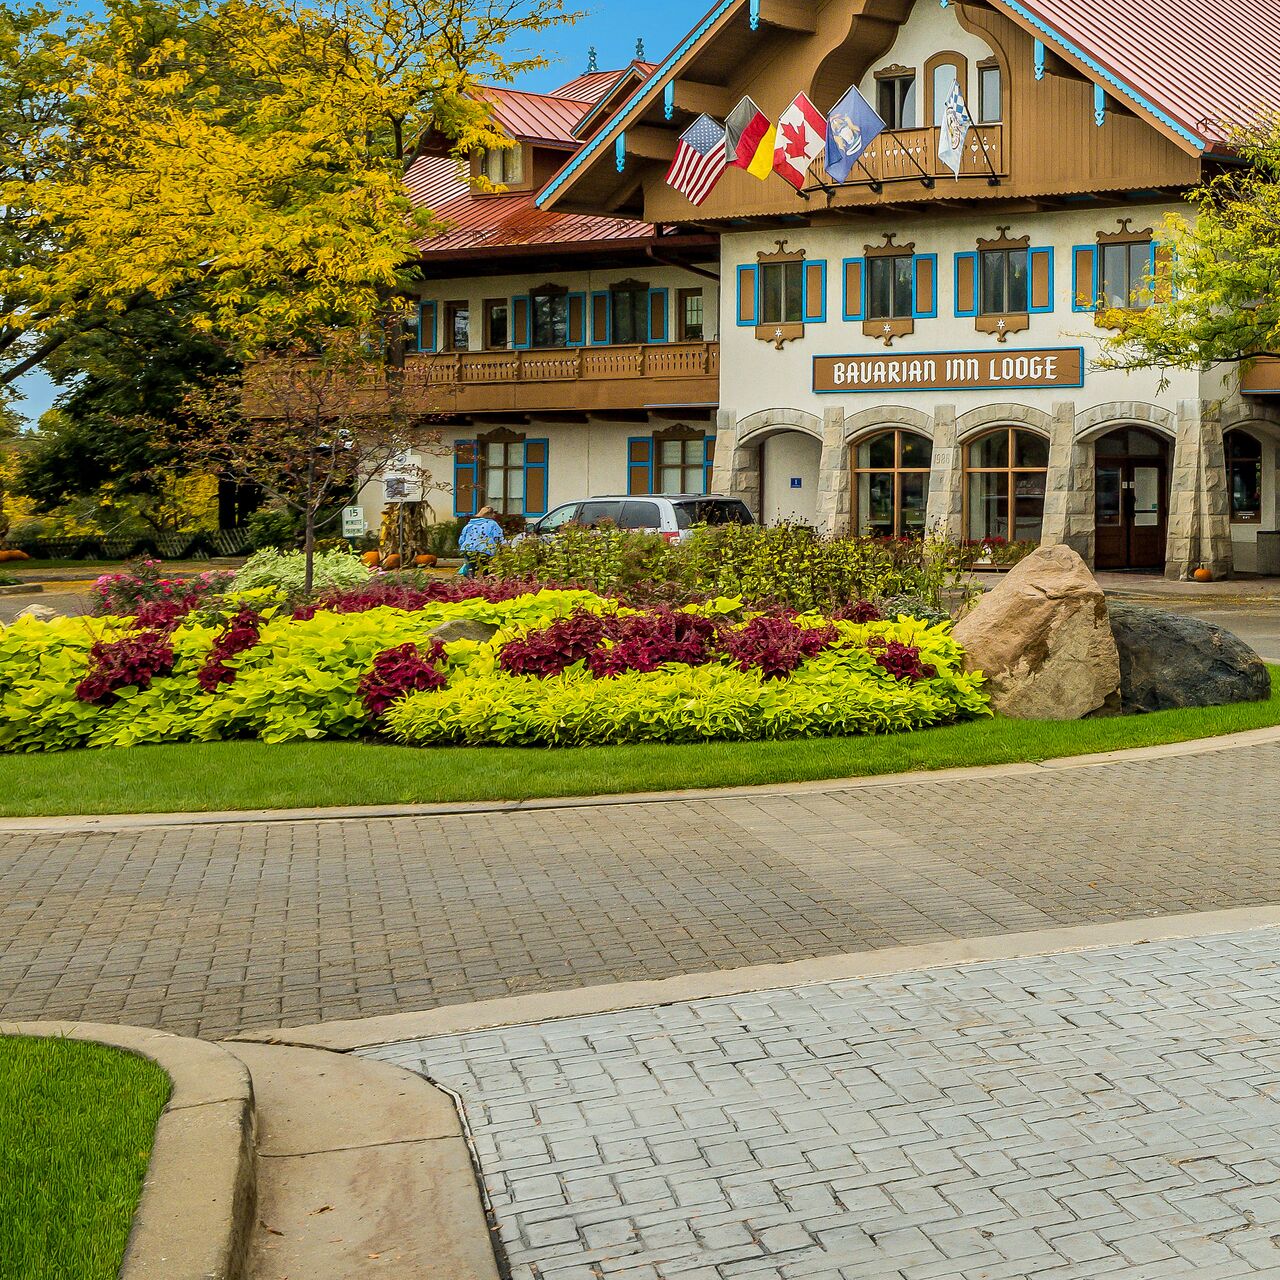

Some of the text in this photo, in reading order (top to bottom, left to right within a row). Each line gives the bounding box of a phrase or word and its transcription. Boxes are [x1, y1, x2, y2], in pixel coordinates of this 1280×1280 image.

[833, 356, 1059, 385] BAVARIAN INN LODGE
